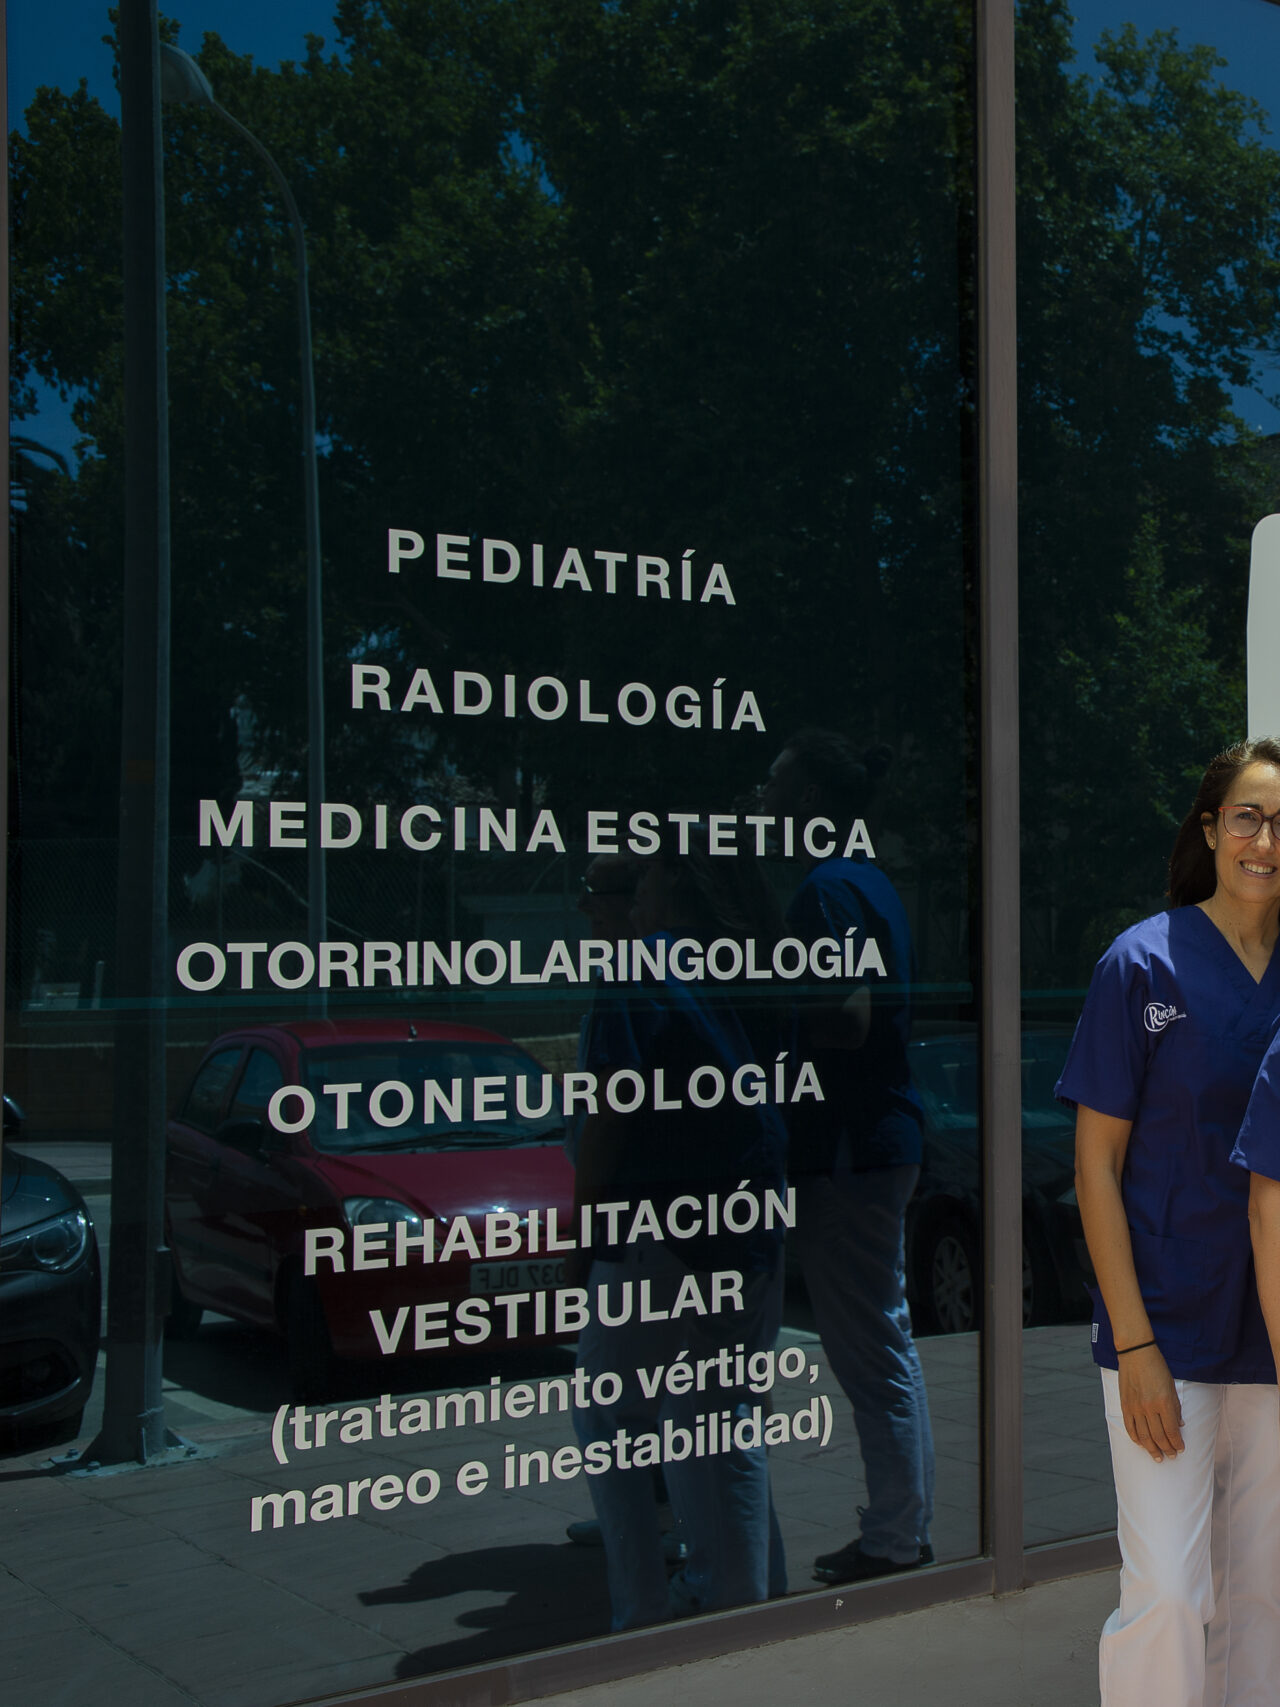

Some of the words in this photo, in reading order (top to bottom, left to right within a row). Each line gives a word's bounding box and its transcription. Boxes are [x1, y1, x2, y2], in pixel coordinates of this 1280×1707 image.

[387, 528, 737, 606] PEDIATRÍA
[351, 664, 767, 732] RADIOLOGÍA
[199, 799, 566, 853] MEDICINA
[587, 810, 876, 859] ESTETICA
[175, 926, 888, 992] OTORRINOLARINGOLOGÍA
[267, 1051, 825, 1134] OTONEUROLOGÍA
[304, 1179, 796, 1276] REHABILITACIÓN
[368, 1270, 745, 1355] VESTIBULAR
[271, 1367, 624, 1465] (tratamiento
[636, 1344, 820, 1399] vértigo,
[250, 1468, 441, 1533] mareo
[456, 1460, 489, 1496] e
[504, 1394, 834, 1490] inestabilidad)
